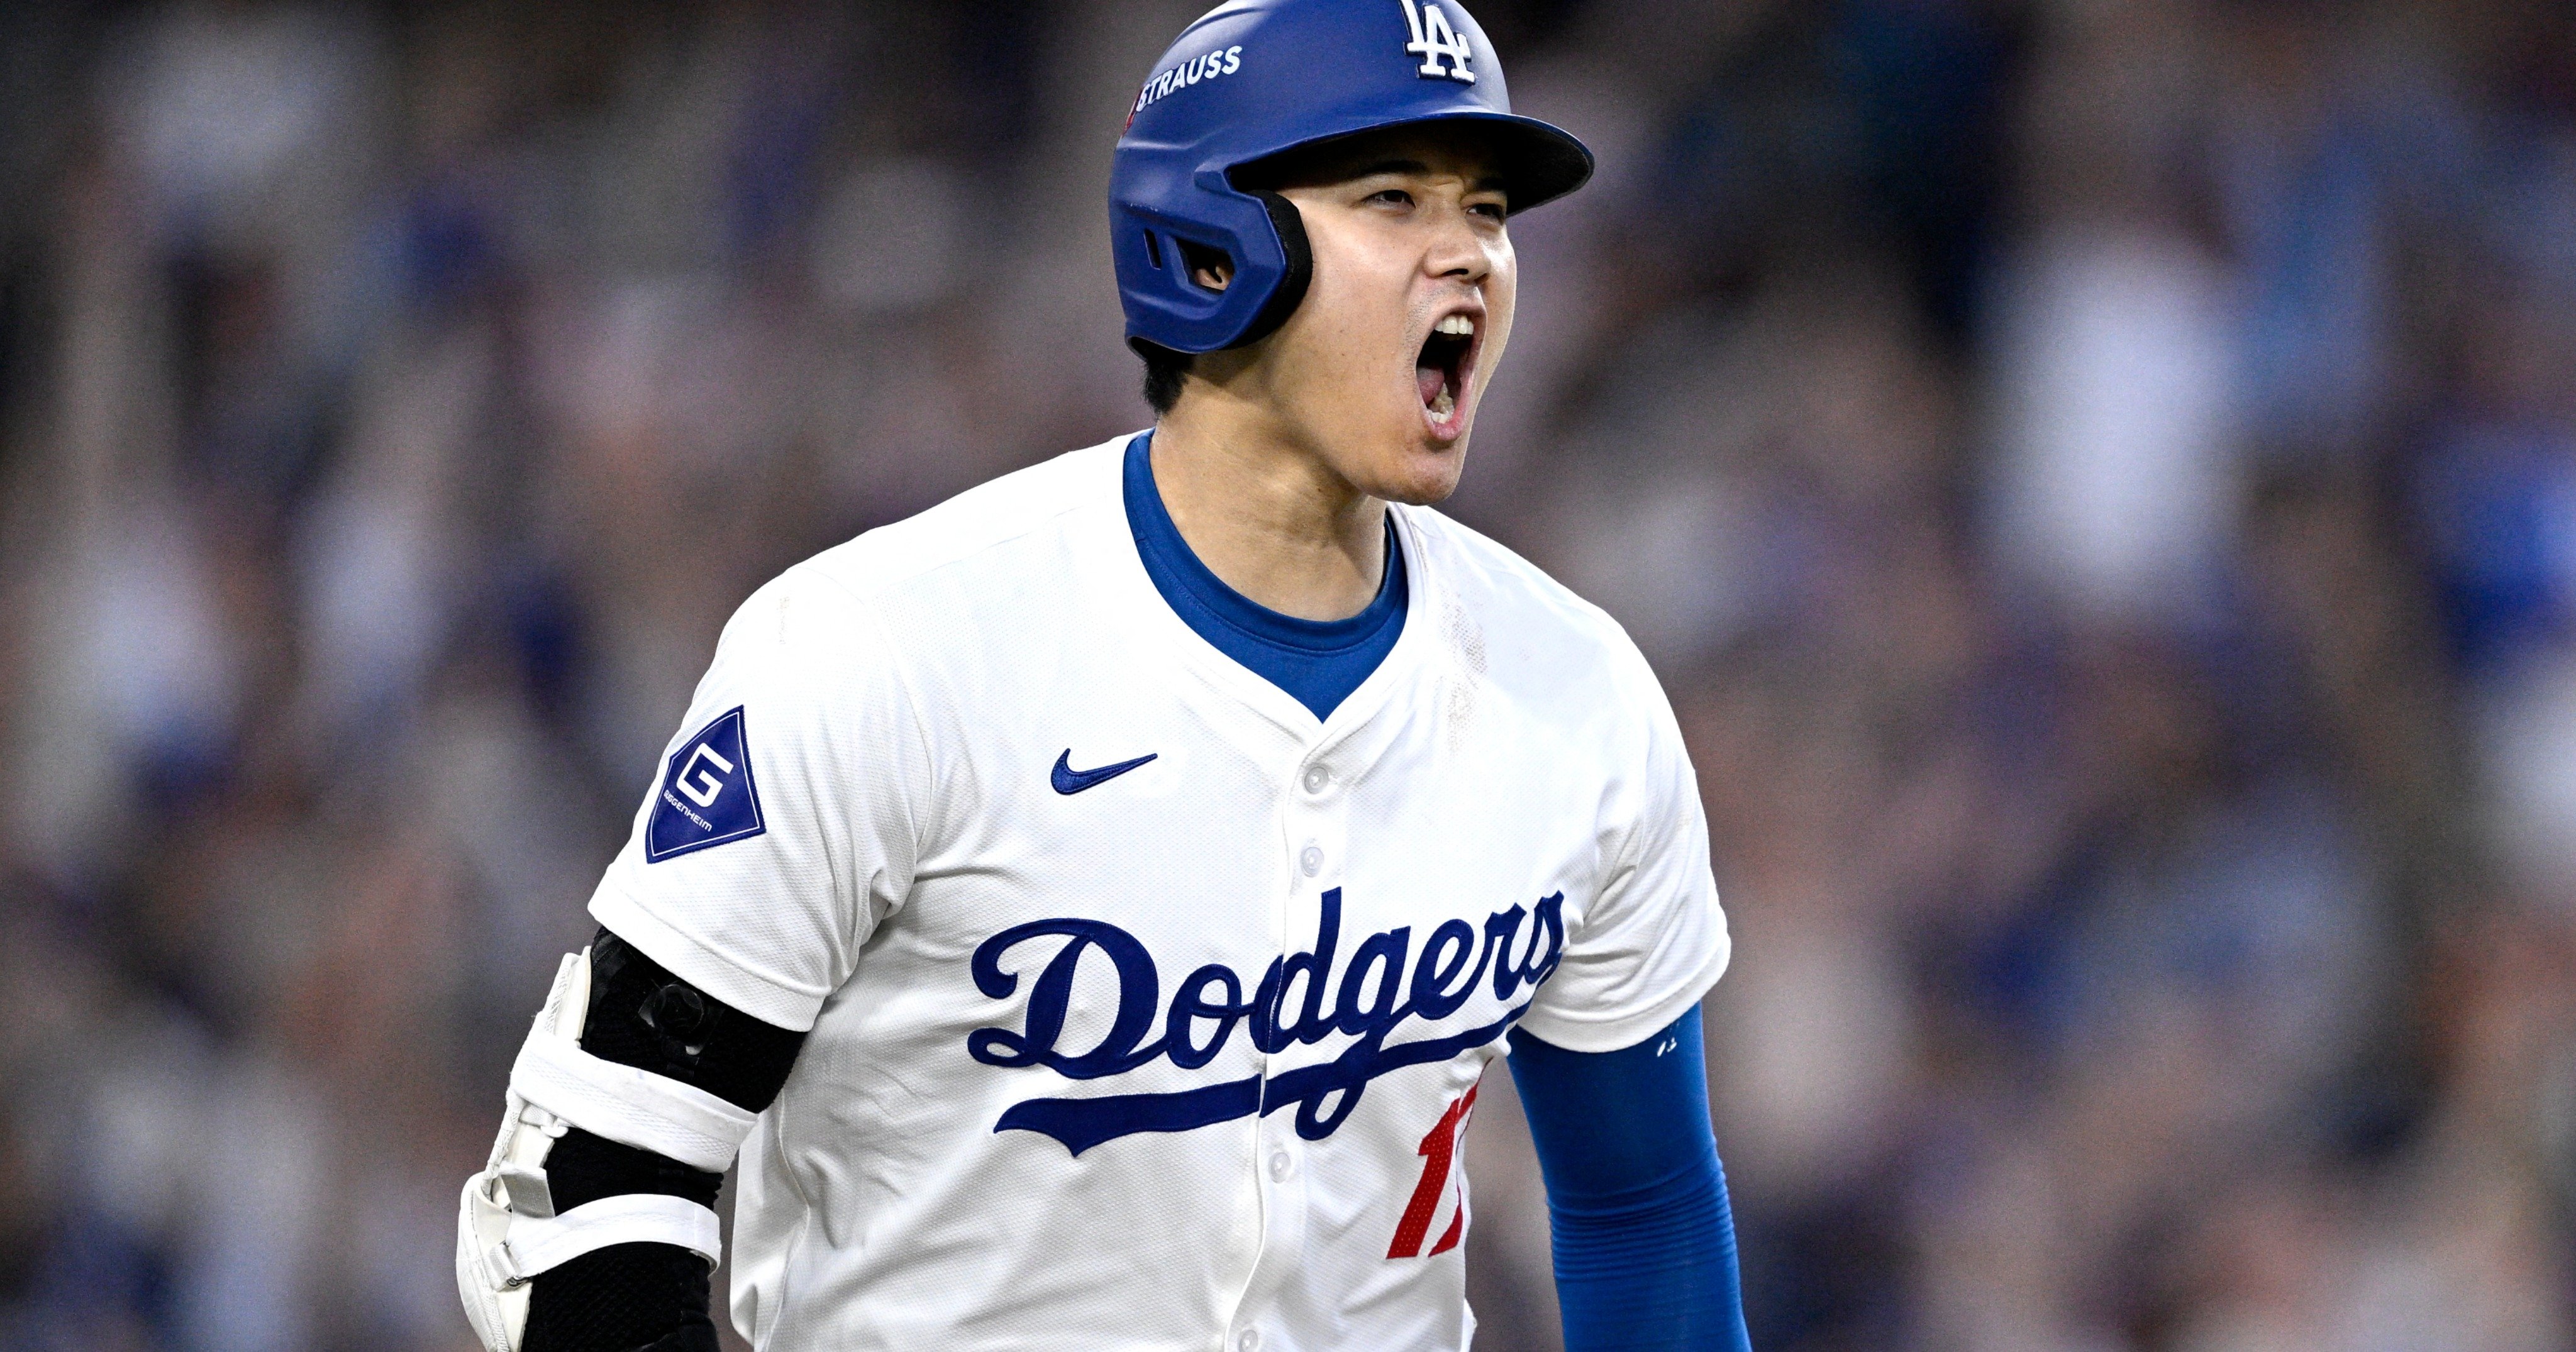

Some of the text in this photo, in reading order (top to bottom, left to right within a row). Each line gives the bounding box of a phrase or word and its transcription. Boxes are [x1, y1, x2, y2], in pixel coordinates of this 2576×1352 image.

[1135, 45, 1243, 112] STRAUSS
[1401, 0, 1475, 84] LA
[676, 743, 734, 807] G
[967, 886, 1565, 1141] Dodgers
